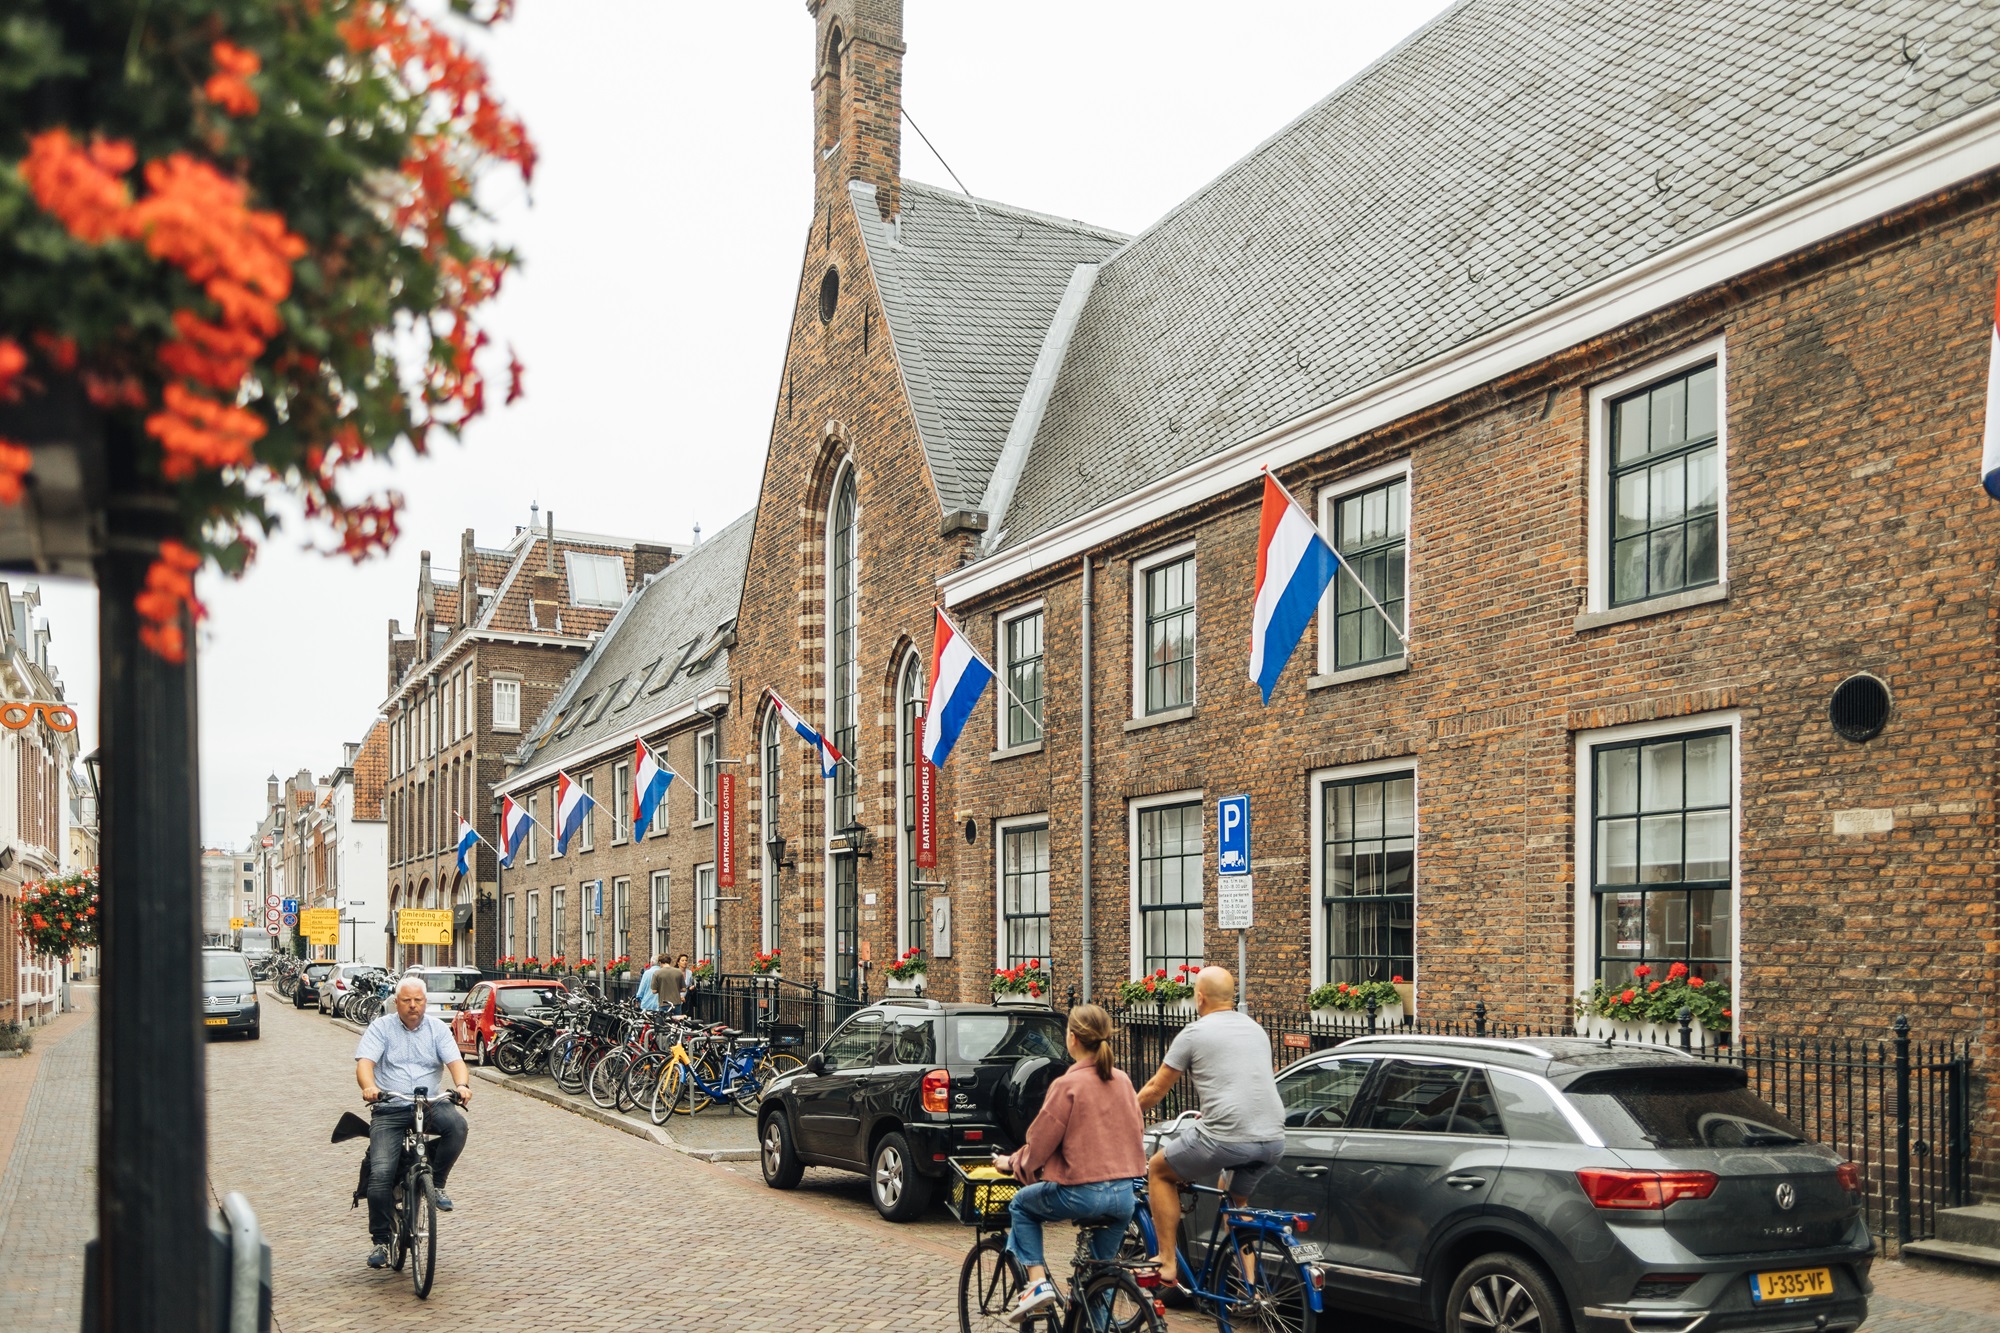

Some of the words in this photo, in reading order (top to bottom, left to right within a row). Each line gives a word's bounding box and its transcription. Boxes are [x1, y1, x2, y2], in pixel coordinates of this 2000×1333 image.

[922, 766, 930, 849] BARTHOLOMEUS
[1224, 804, 1240, 842] P
[402, 911, 435, 919] Omleiding
[1764, 1226, 1803, 1234] T-ROC
[1292, 1246, 1304, 1255] GK
[1303, 1244, 1320, 1254] 097
[1767, 1272, 1825, 1295] J-335-VF
